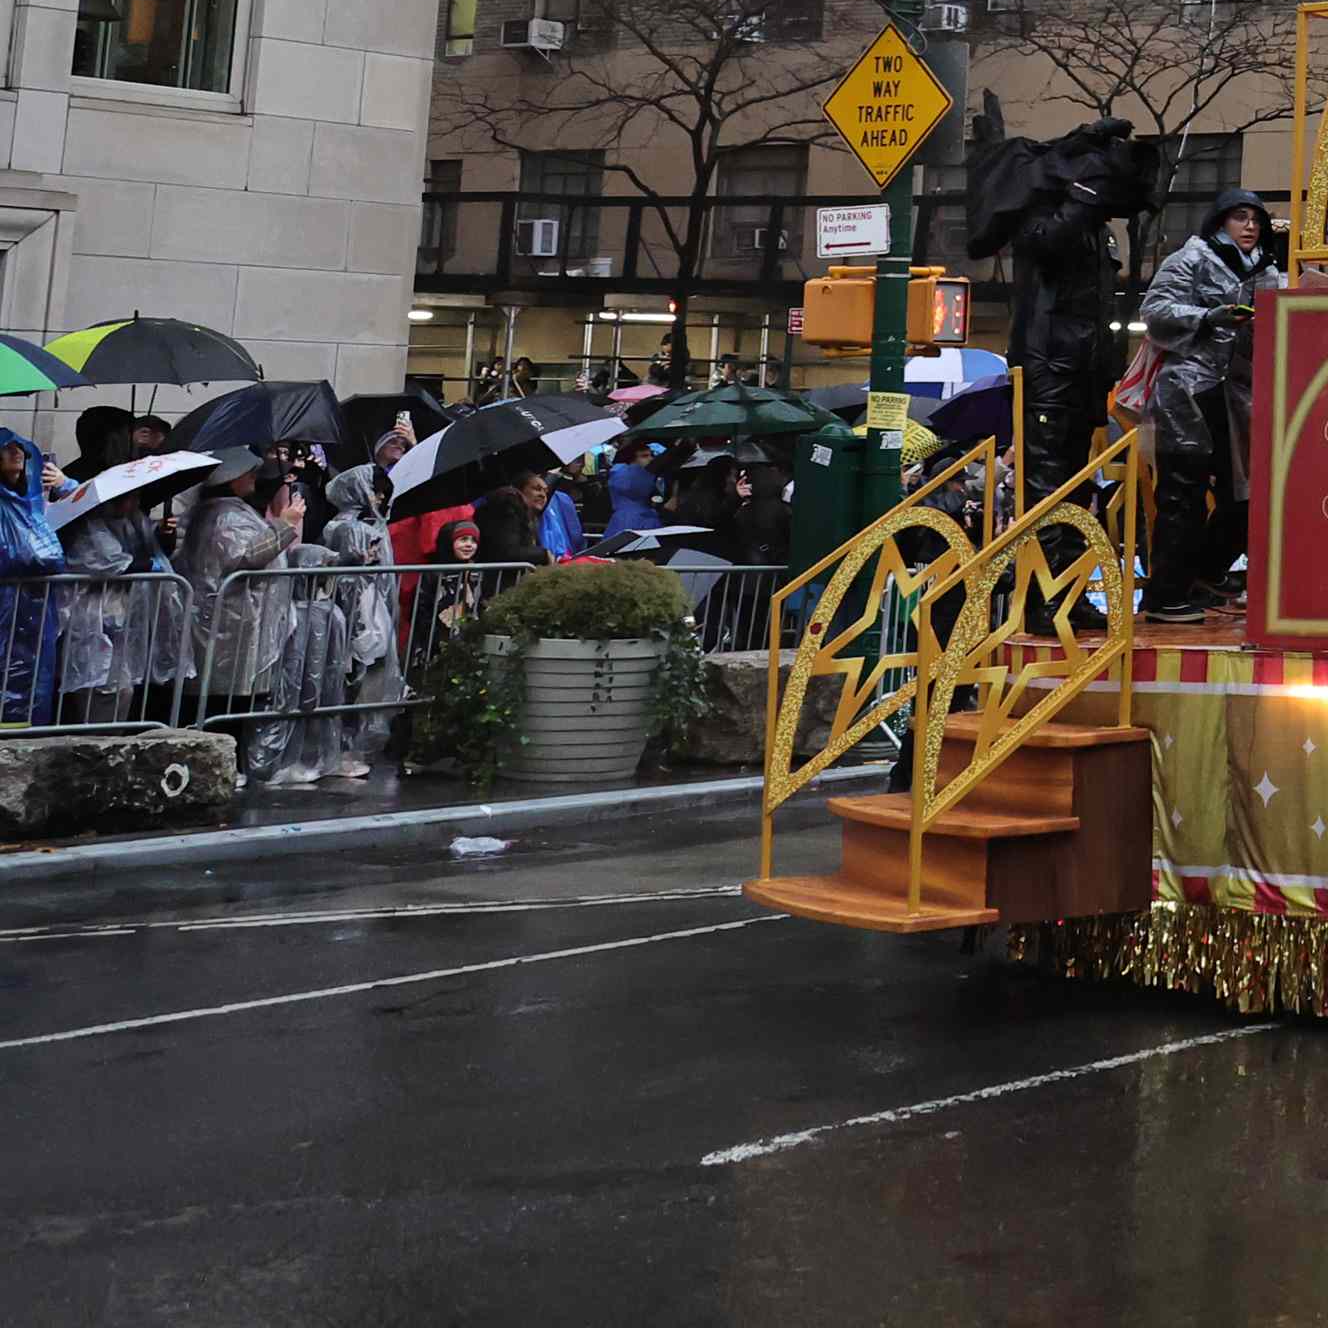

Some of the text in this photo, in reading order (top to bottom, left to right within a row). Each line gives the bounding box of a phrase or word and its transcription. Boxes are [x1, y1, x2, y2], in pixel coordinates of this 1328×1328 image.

[874, 55, 904, 73] TWO
[872, 80, 902, 98] WAY
[857, 104, 915, 123] TRAFFIC
[860, 129, 908, 147] AHEAD
[822, 211, 873, 223] NO PARKING
[823, 224, 857, 235] Anytime
